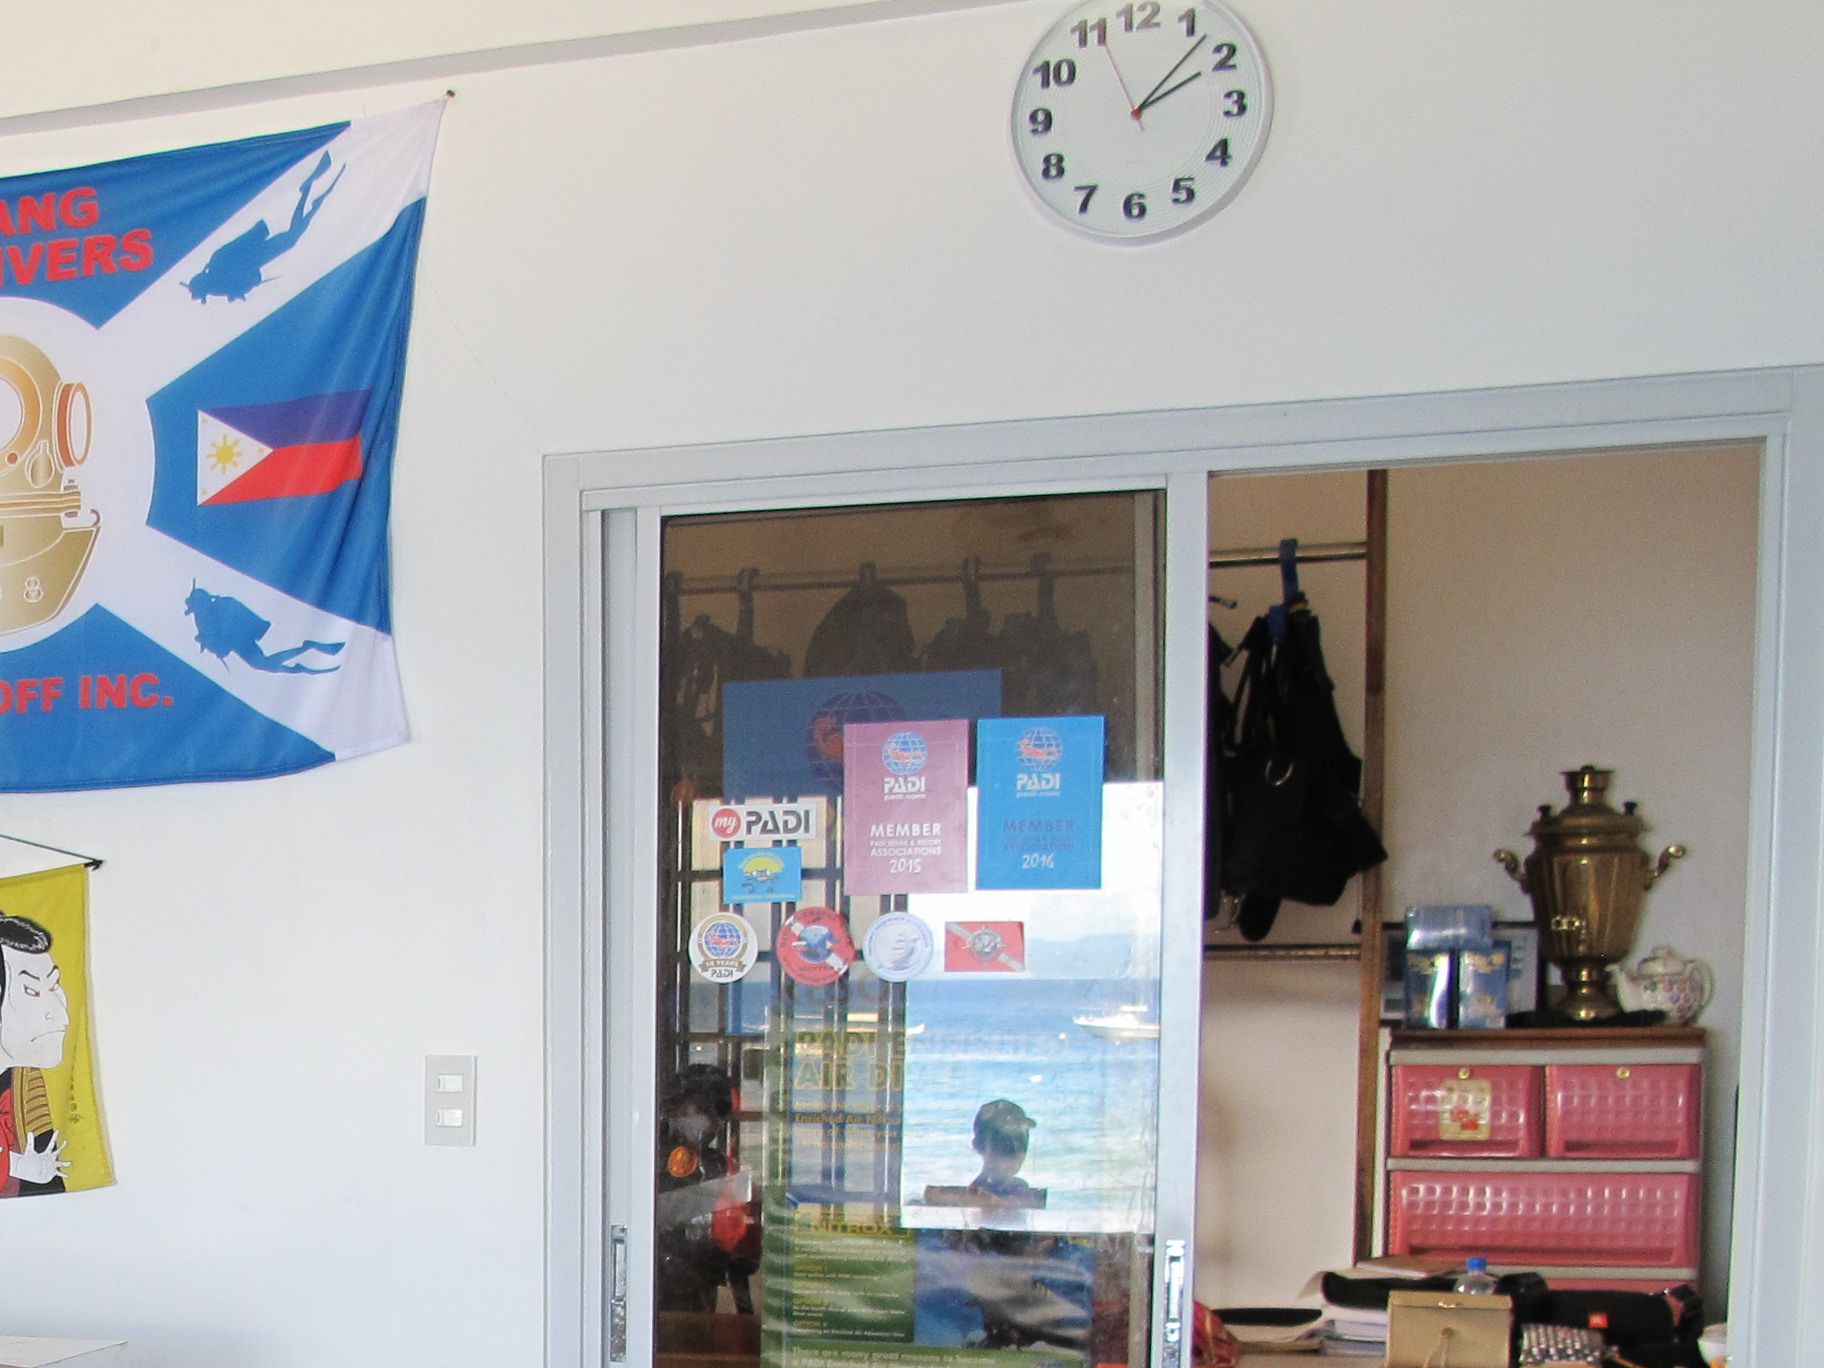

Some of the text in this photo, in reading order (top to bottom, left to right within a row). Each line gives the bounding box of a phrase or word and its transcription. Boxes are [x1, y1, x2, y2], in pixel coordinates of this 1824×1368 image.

[1116, 2, 1161, 32] 12
[1178, 8, 1196, 37] 1
[1071, 18, 1107, 48] 11
[1212, 43, 1237, 71] 2
[1033, 59, 1076, 88] 10
[1223, 90, 1247, 117] 3
[1029, 108, 1052, 134] 9
[1205, 138, 1231, 167] 4
[1042, 153, 1065, 180] 8
[1074, 185, 1098, 214] 7
[1172, 177, 1195, 204] 5
[1123, 193, 1146, 220] 6
[80, 674, 174, 709] INC.
[884, 776, 926, 793] PADI
[1016, 773, 1061, 790] PADI
[714, 809, 810, 835] my PADI
[870, 823, 941, 837] MEMBER
[1003, 820, 1073, 832] MEMBER
[870, 847, 941, 857] ASSOCIATIONS
[890, 858, 921, 873] 2015
[1022, 853, 1055, 869] 2016
[711, 967, 733, 978] PADI
[715, 958, 738, 967] YEARS
